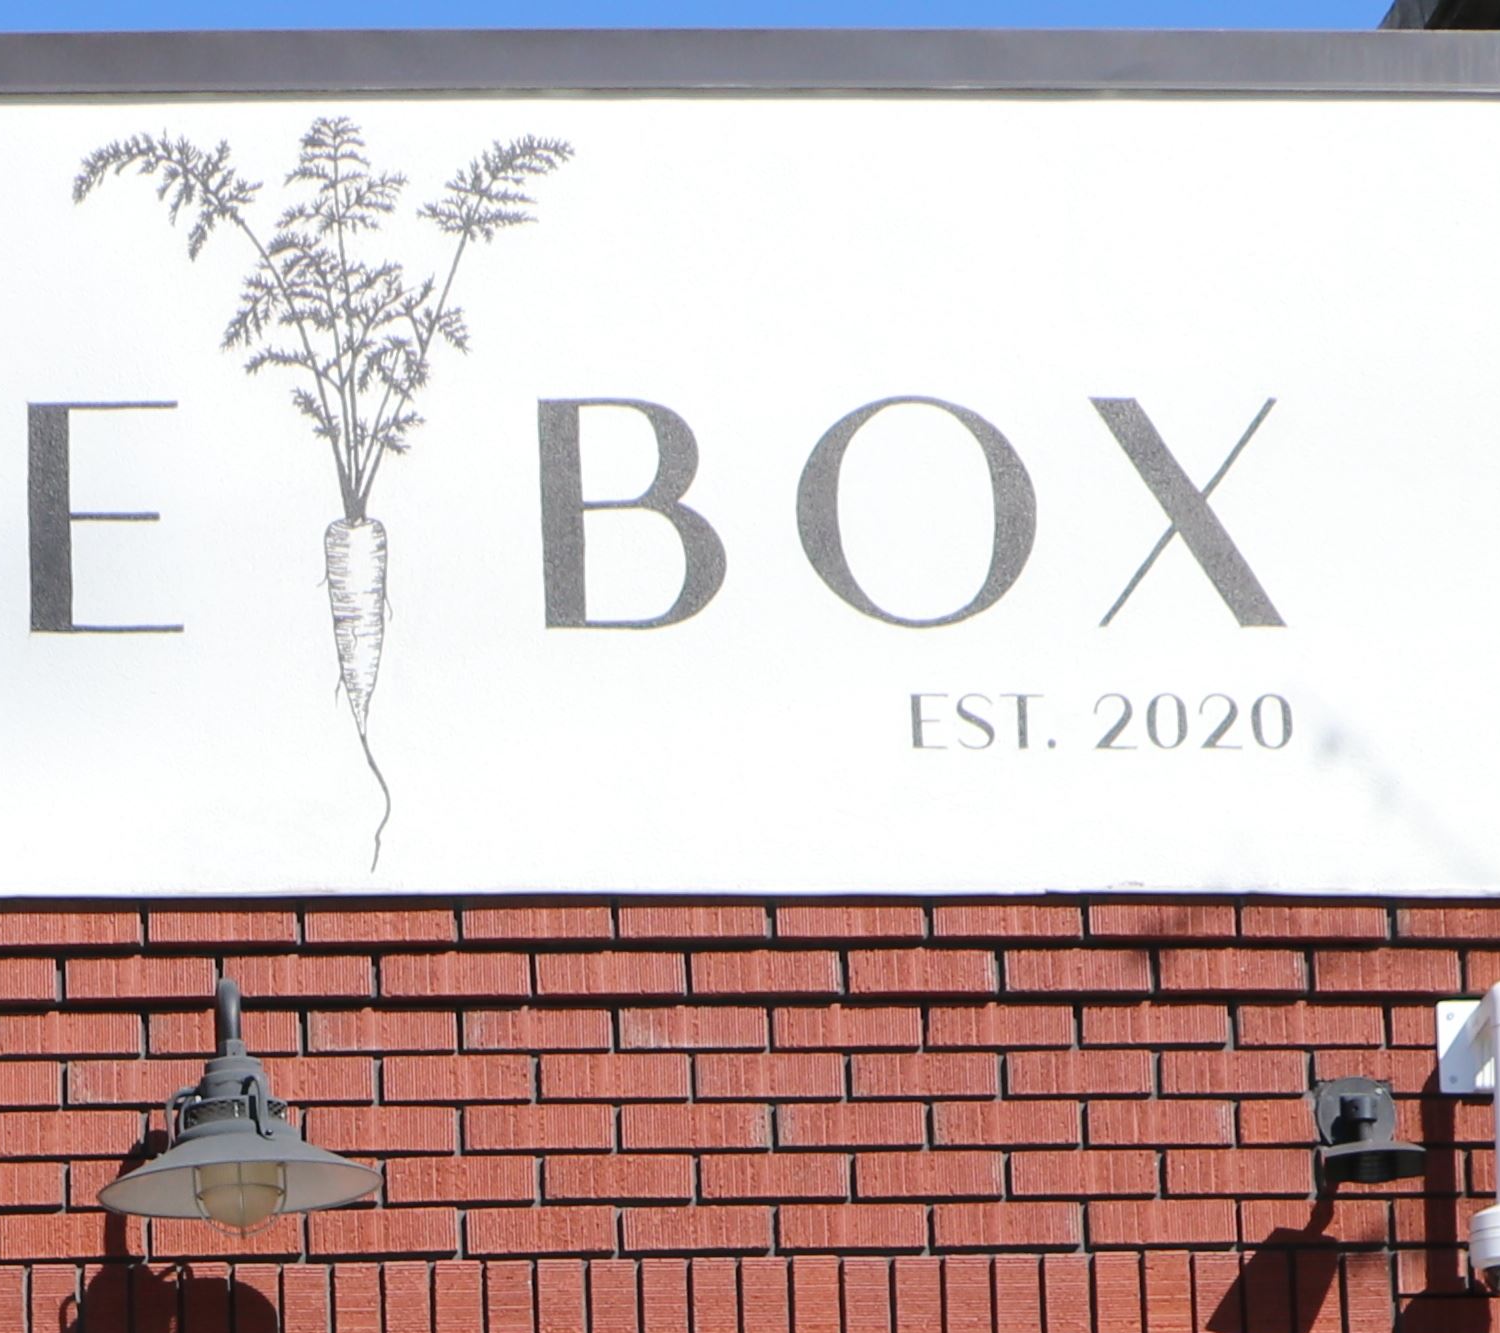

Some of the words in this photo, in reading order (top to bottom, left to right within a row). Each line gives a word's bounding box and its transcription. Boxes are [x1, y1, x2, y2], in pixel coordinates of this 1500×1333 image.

[537, 395, 1287, 631] BOX
[909, 692, 1058, 751] EST.
[1092, 692, 1294, 751] 2020
